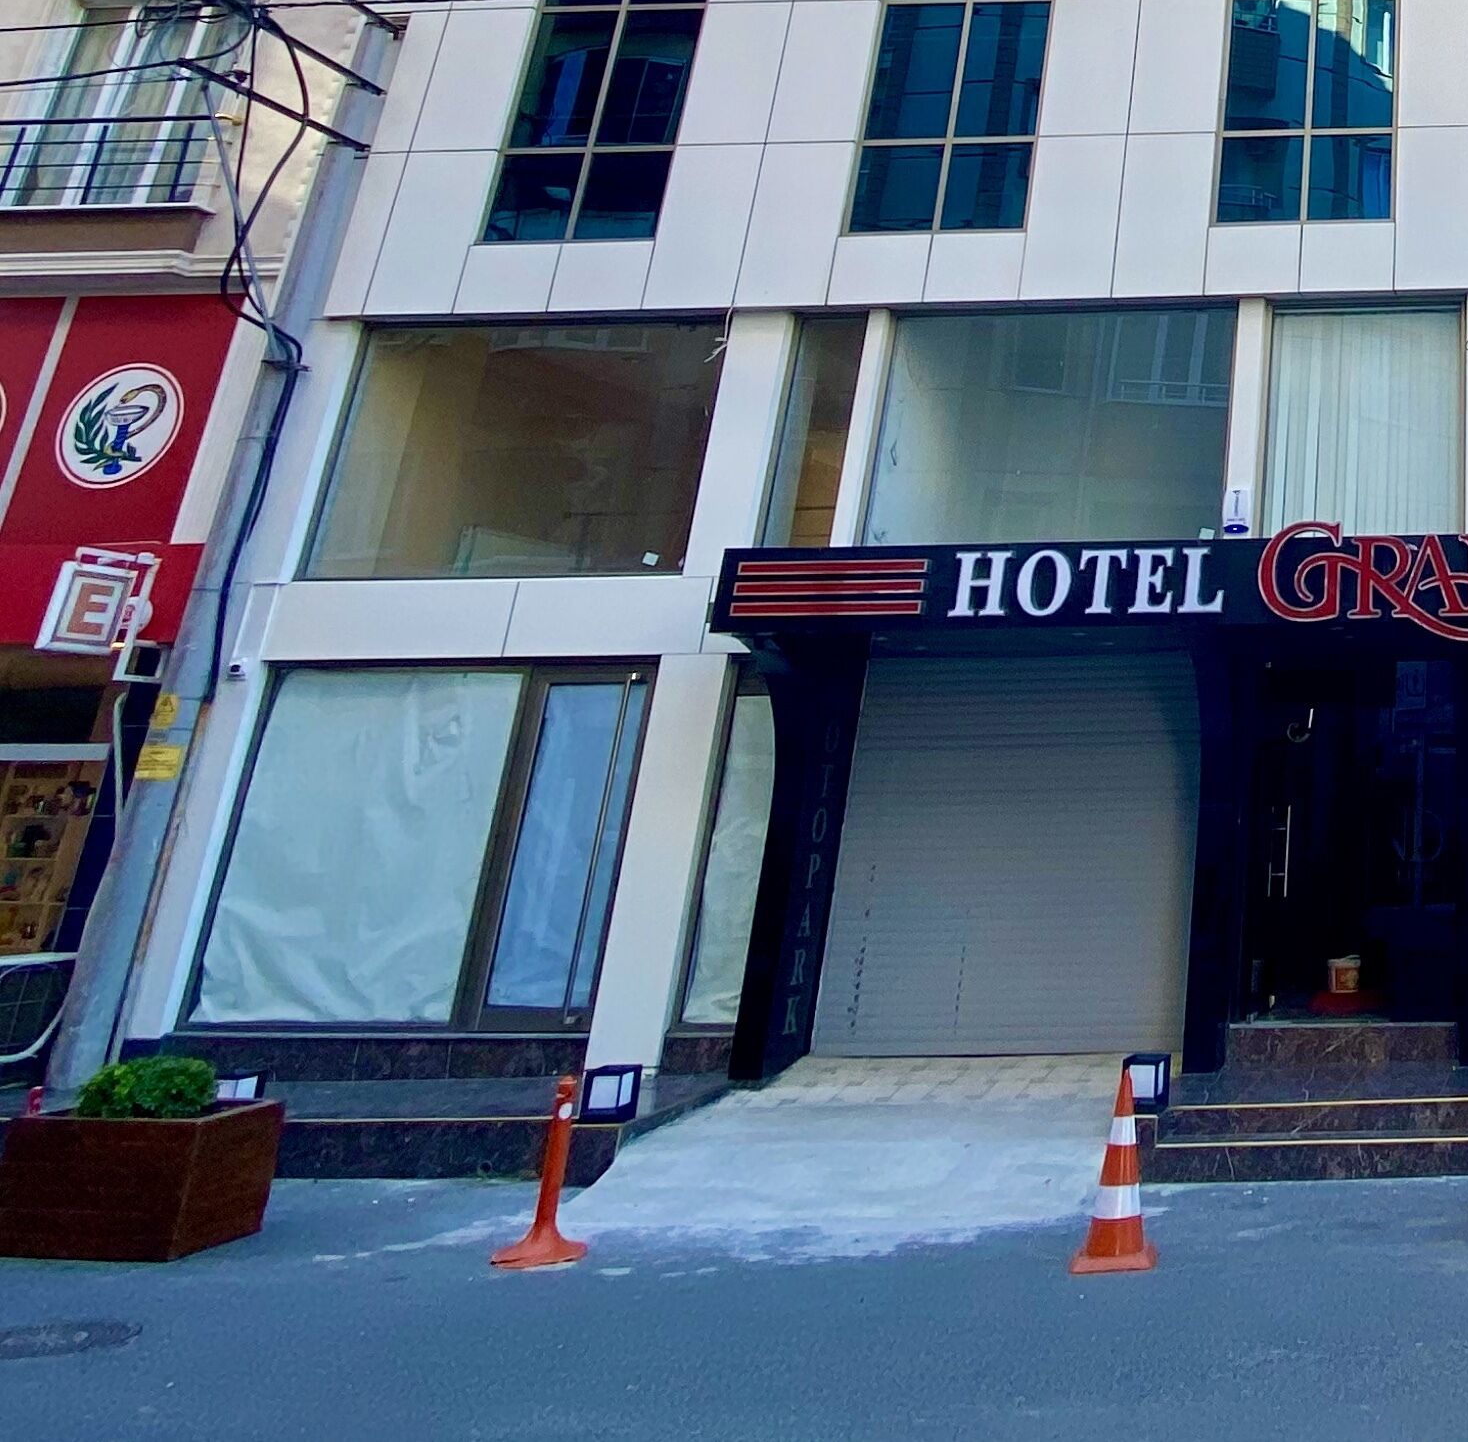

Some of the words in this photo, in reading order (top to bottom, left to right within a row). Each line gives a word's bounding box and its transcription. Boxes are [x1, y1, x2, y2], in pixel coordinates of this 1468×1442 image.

[66, 582, 116, 636] E
[947, 549, 1225, 617] HOTEL
[781, 719, 840, 1036] OTOPARK
